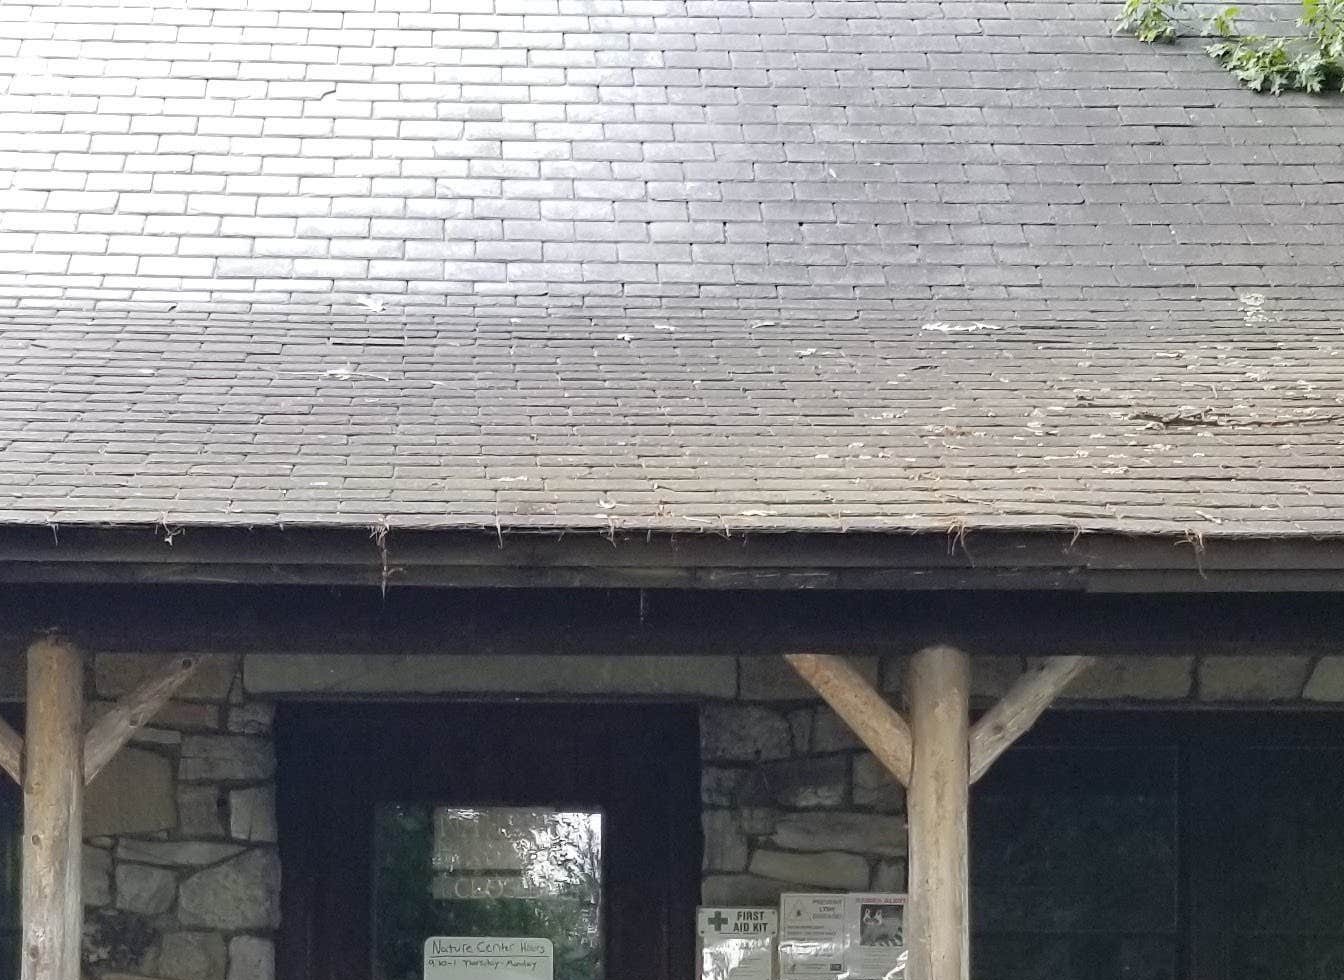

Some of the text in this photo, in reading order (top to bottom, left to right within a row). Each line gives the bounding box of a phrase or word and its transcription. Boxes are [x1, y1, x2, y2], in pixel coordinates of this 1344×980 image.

[736, 911, 765, 921] FIRST
[733, 922, 769, 932] AID KIT
[432, 940, 545, 954] Nature Center Hours
